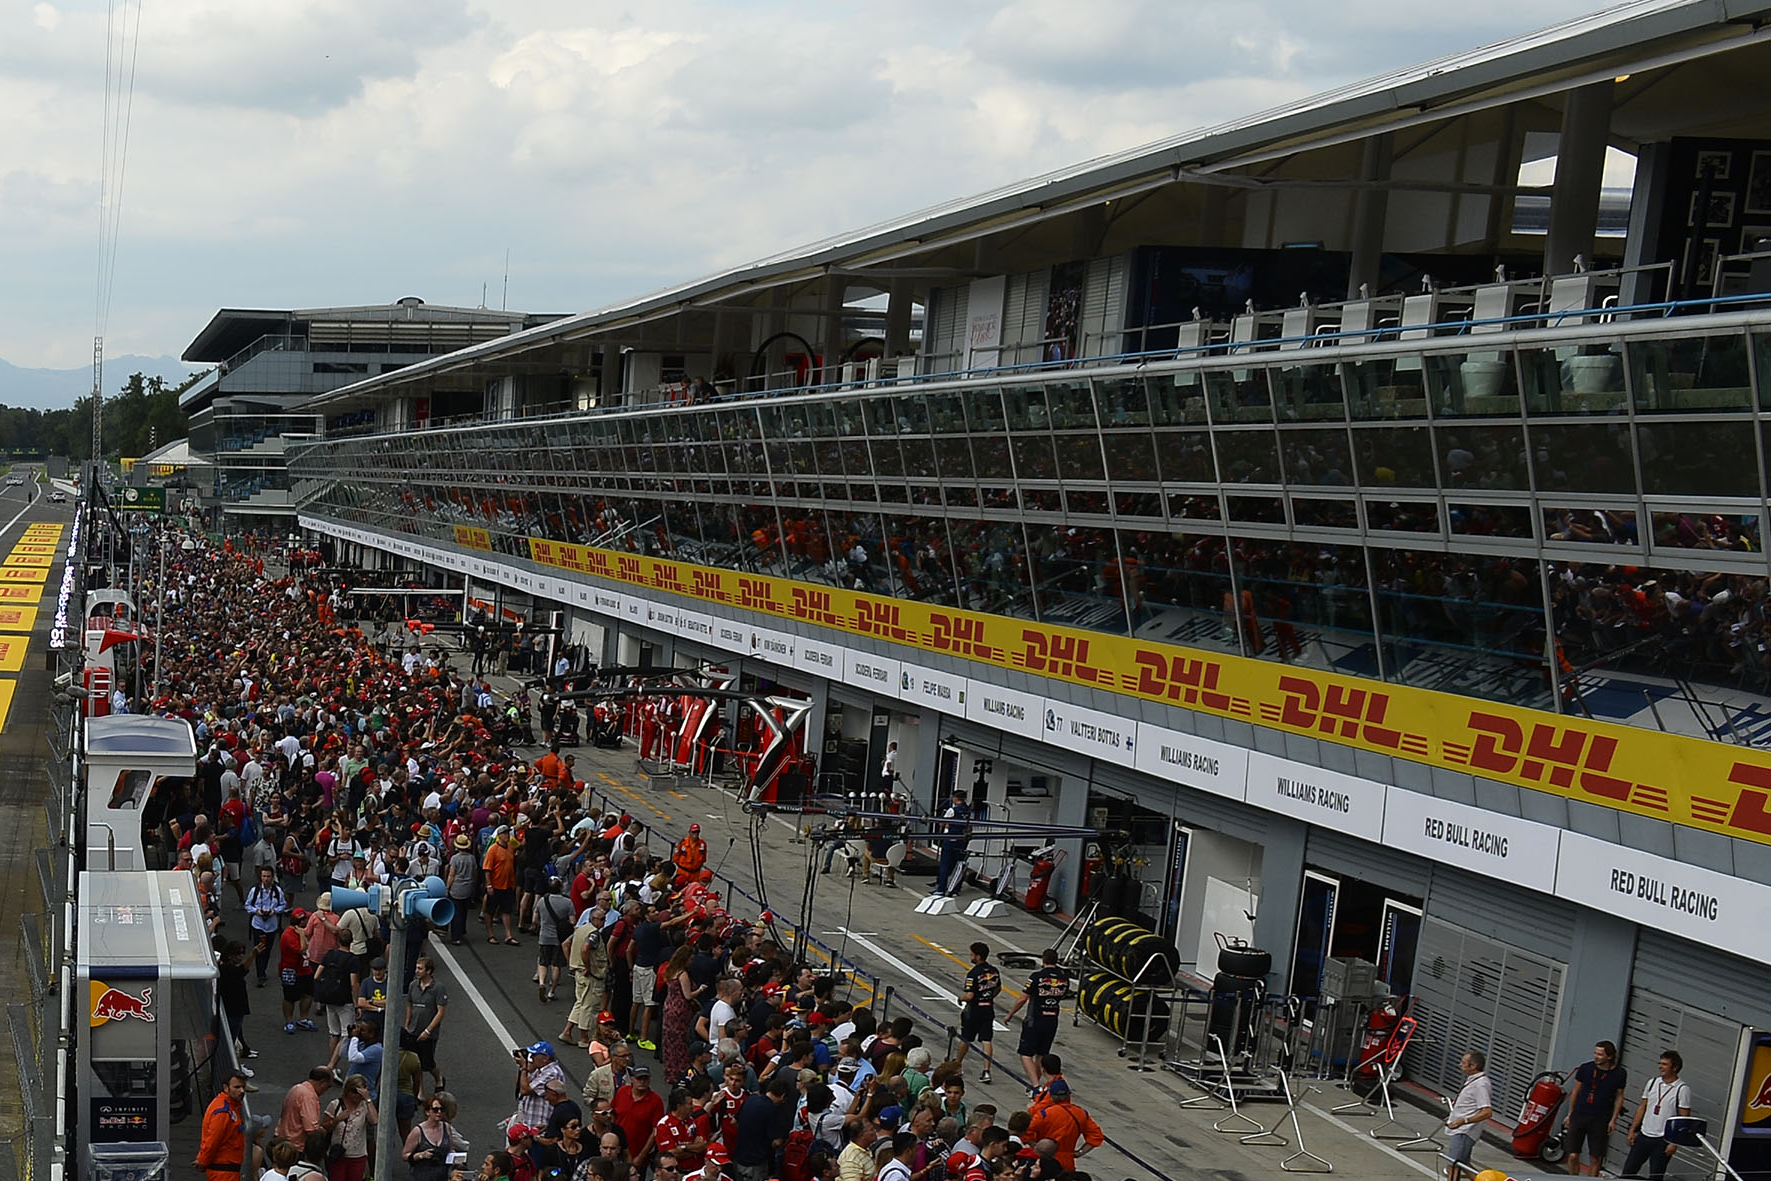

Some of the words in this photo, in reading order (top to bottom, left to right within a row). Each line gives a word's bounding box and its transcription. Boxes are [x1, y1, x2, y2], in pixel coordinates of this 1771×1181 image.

[588, 552, 610, 577] DHL
[618, 557, 644, 583] DHL
[653, 564, 682, 591] DHL
[693, 571, 726, 600] DHL
[739, 578, 776, 611] DHL
[792, 588, 836, 625] DHL
[855, 599, 906, 640] DHL
[930, 613, 991, 659] DHL
[1022, 629, 1098, 682] DHL
[923, 680, 937, 697] FELIPE
[937, 684, 952, 701] MASSA
[1135, 650, 1231, 711] DHL
[983, 697, 1006, 717] WILLIAMS
[1006, 703, 1025, 721] RACING
[1279, 676, 1401, 749] DHL
[1056, 716, 1064, 732] 77
[1070, 720, 1097, 742] VALTTERI
[1097, 727, 1120, 748] BOTTAS
[1160, 745, 1192, 769] WILLIAMS
[1192, 754, 1219, 777] RACING
[1467, 711, 1633, 802] DHL
[1277, 776, 1317, 805] WILLIAMS
[1317, 789, 1350, 814] RACING
[1424, 817, 1444, 840] RED
[1446, 823, 1469, 848] BULL
[1471, 829, 1509, 858] RACING
[1610, 868, 1635, 895] RED
[1637, 878, 1667, 906] BULL
[1670, 889, 1718, 921] RACING
